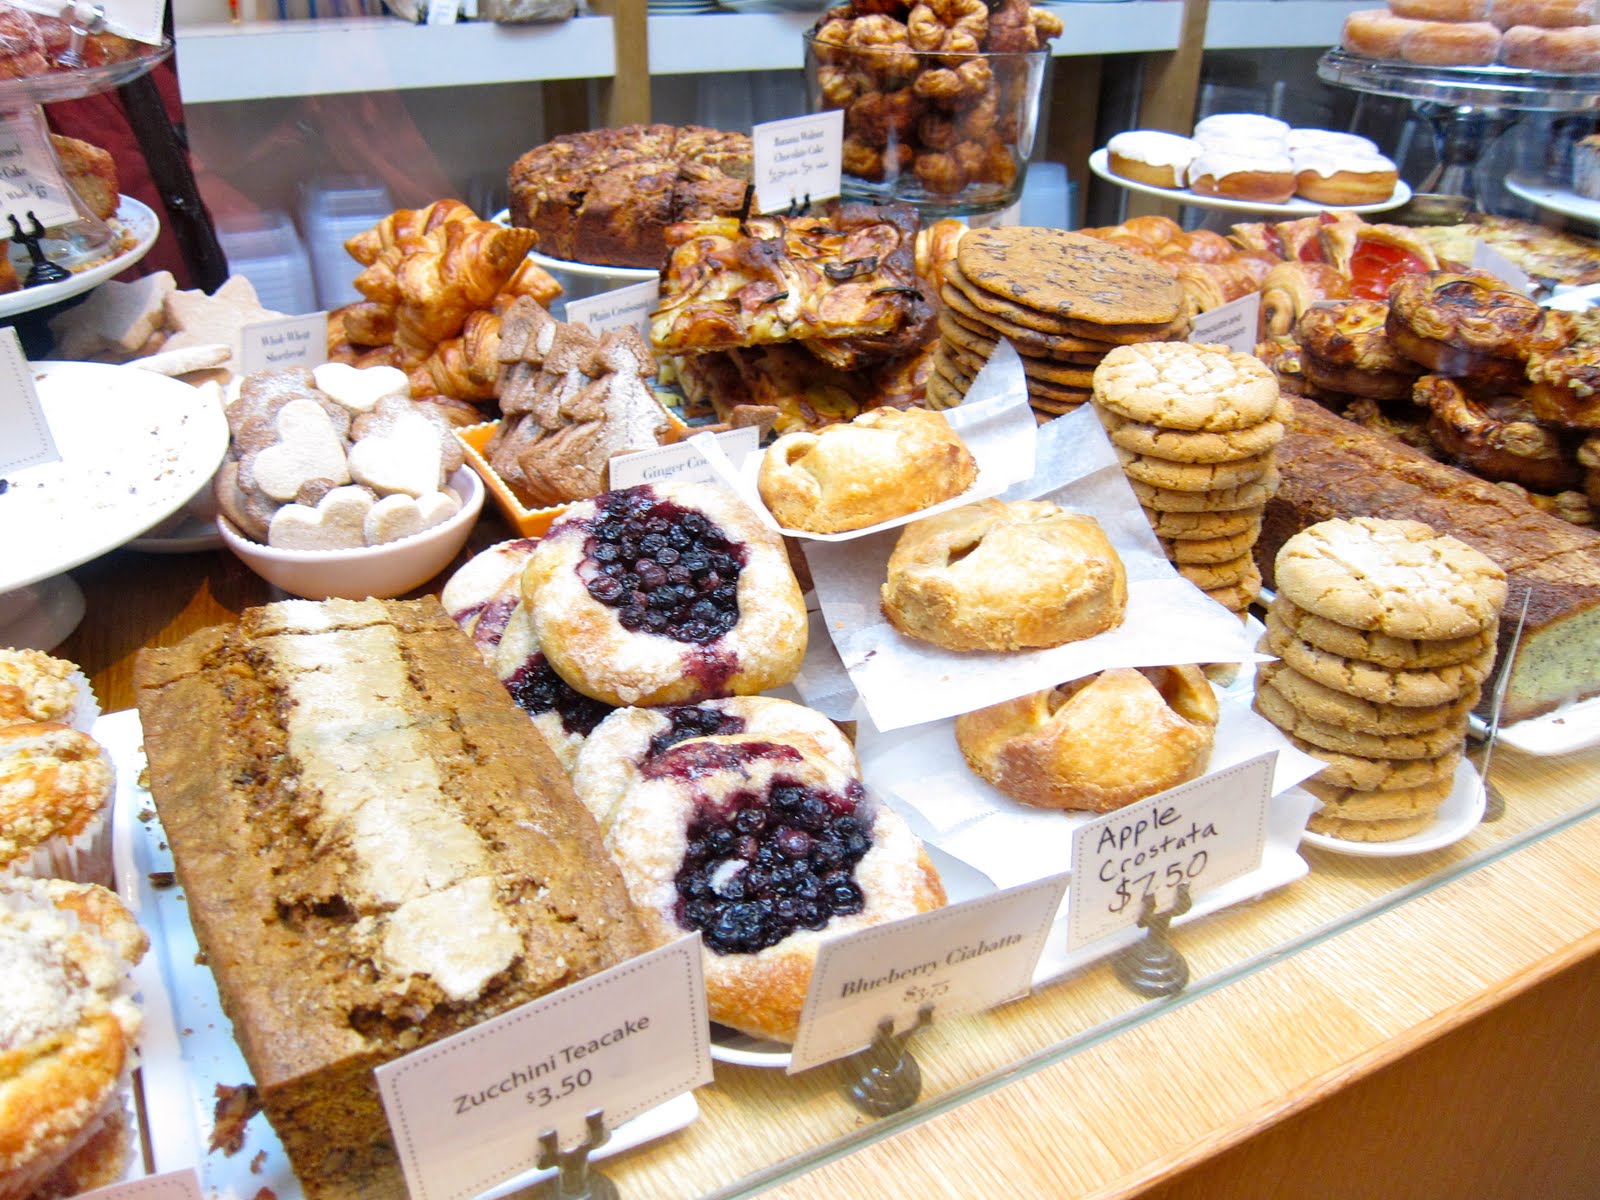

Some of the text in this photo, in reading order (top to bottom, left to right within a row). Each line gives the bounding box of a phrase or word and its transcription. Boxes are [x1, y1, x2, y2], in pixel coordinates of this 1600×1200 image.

[642, 463, 686, 481] Ginger
[1097, 806, 1183, 854] Apple
[1098, 821, 1219, 882] Crostata
[840, 932, 1023, 998] Blueberry Ciabatta
[453, 1013, 651, 1116] Zucchini Teacake
[526, 1068, 593, 1108] $3.50
